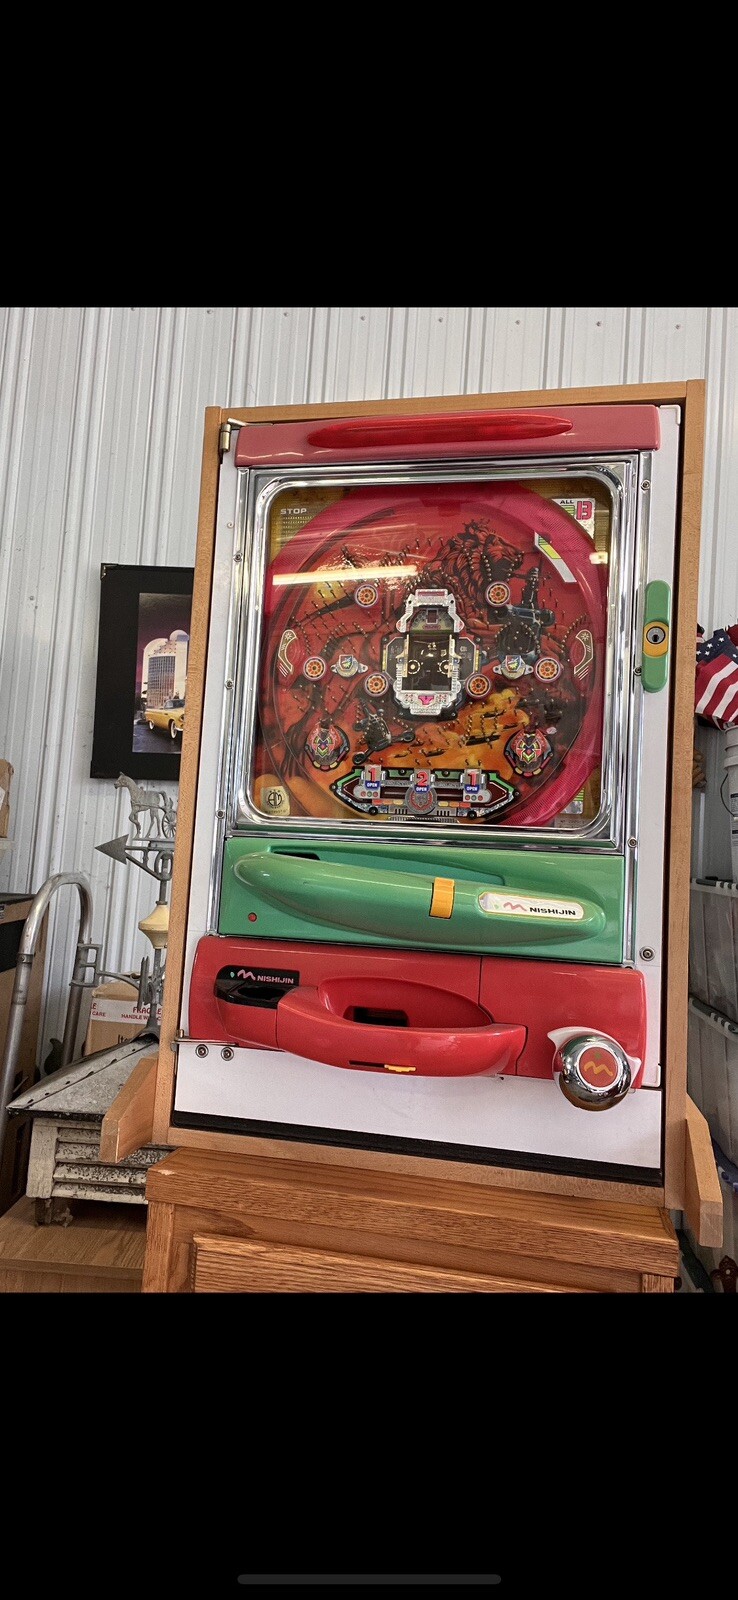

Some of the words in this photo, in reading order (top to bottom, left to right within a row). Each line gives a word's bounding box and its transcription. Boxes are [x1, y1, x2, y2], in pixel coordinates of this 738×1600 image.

[280, 507, 307, 515] STOP
[368, 767, 377, 782] 1
[416, 771, 429, 786] 2
[467, 771, 478, 786] 1
[529, 907, 576, 916] NISHIJIN
[257, 975, 294, 984] NISHIJIN
